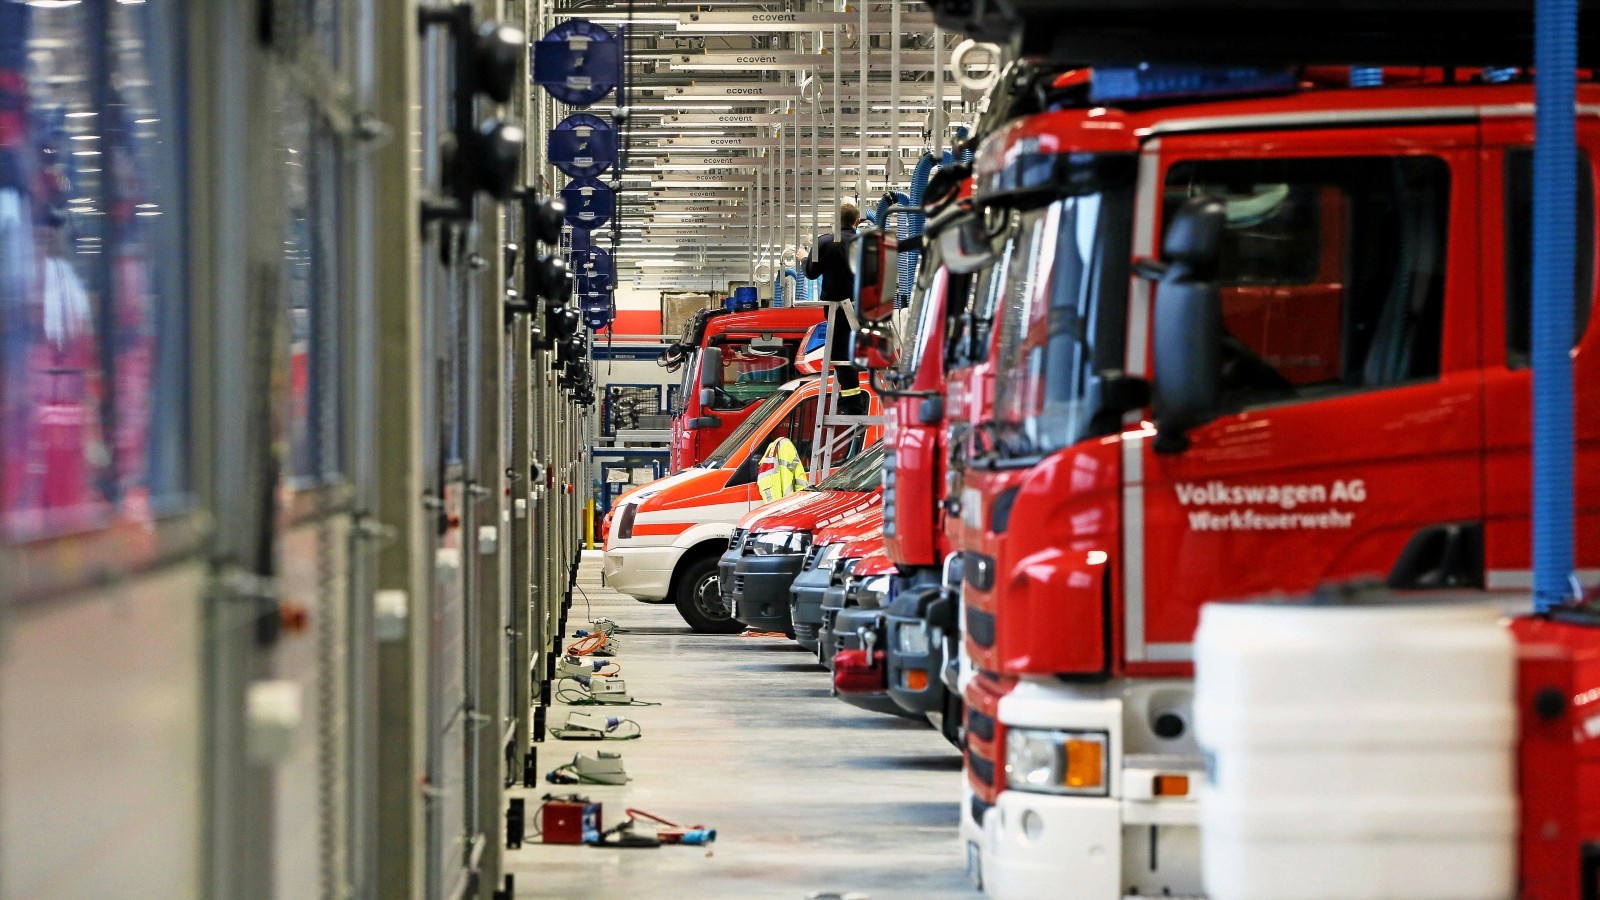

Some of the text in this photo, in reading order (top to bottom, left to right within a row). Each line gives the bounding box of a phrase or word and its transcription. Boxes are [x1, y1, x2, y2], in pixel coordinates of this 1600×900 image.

[752, 13, 797, 22] ecovent
[1175, 479, 1367, 509] Volkswagen AG
[1188, 509, 1355, 531] Werkfeuerwehr
